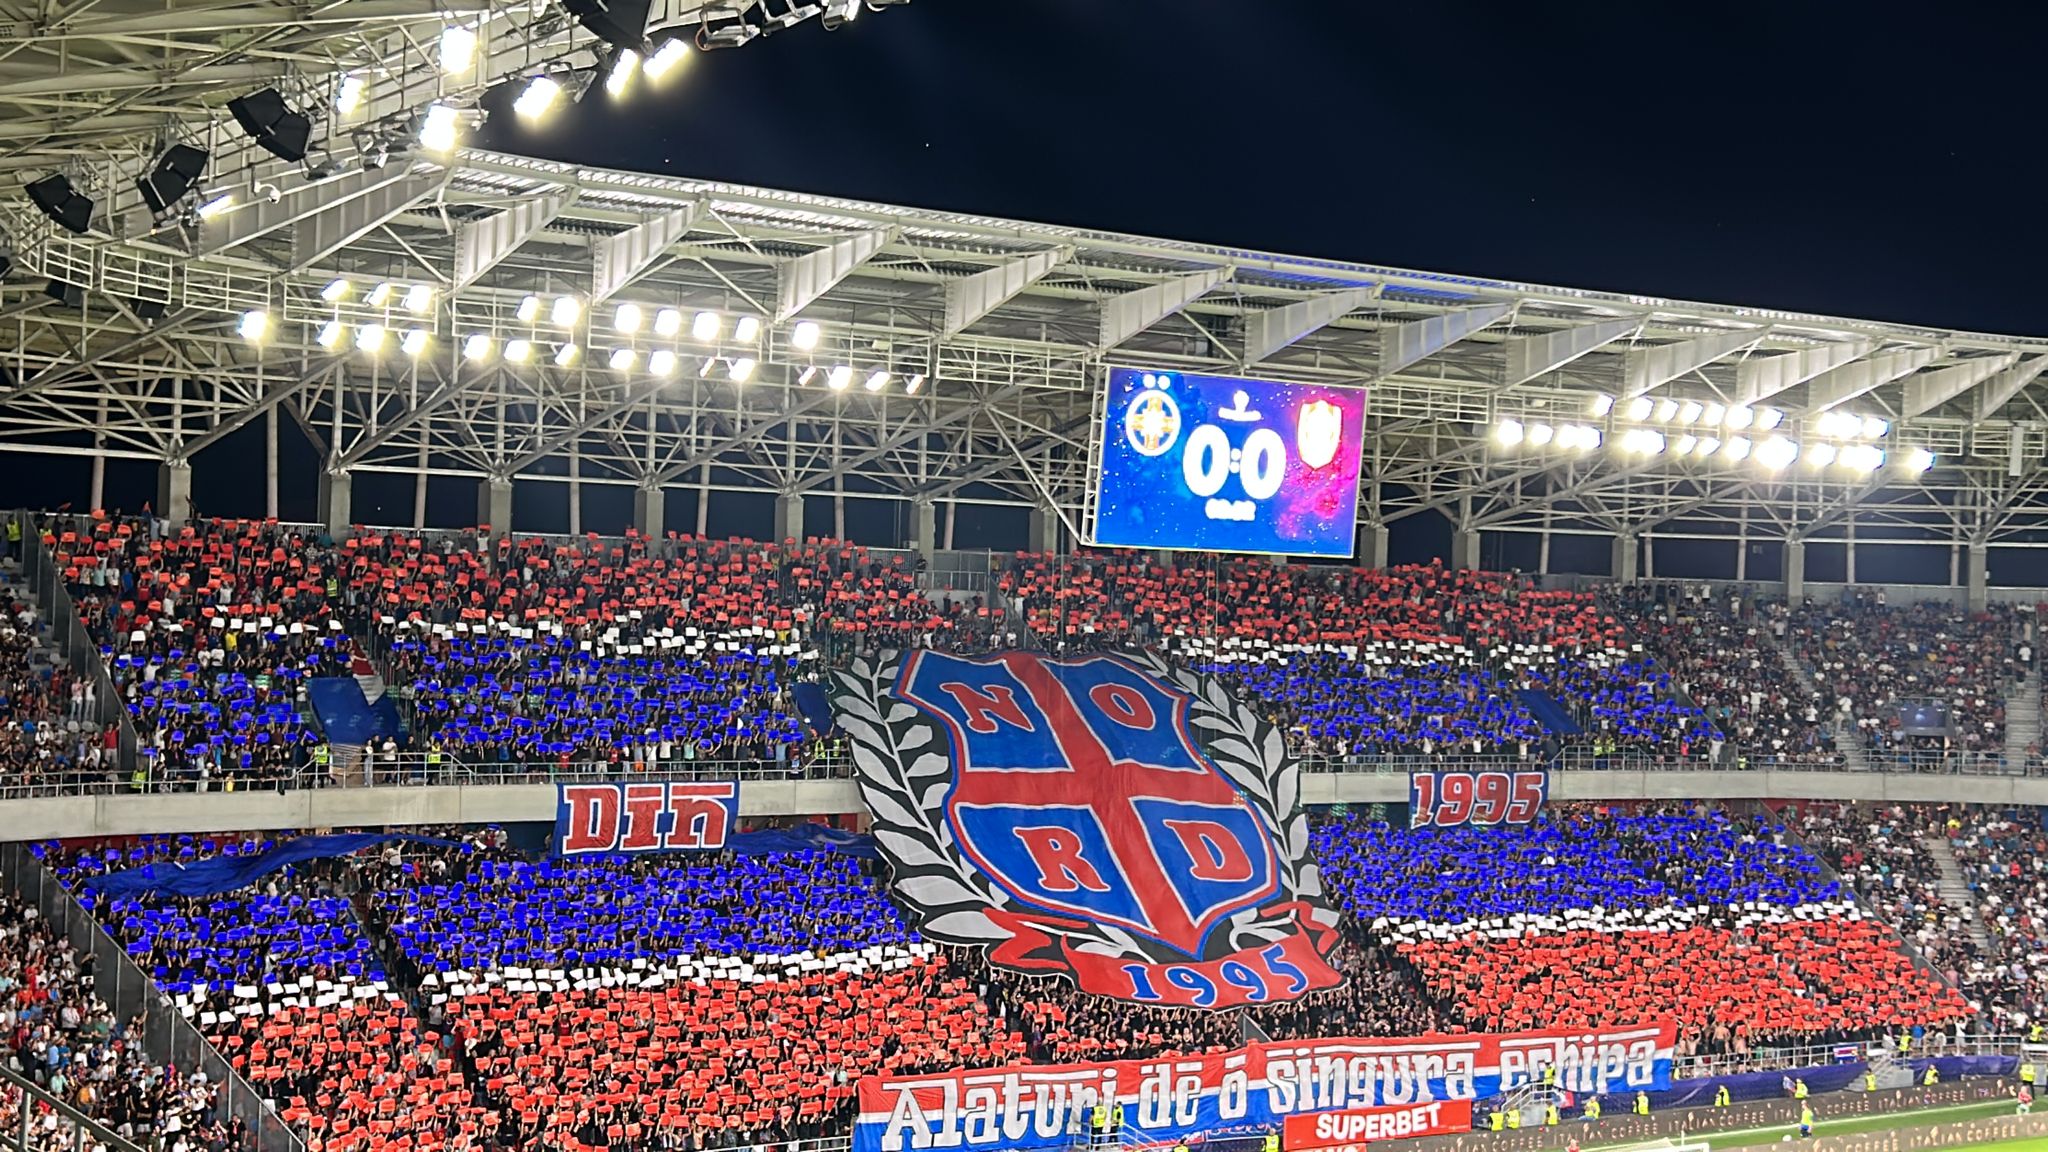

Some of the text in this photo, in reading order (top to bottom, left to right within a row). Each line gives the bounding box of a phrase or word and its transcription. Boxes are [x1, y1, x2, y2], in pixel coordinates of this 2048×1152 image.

[1411, 772, 1544, 830] 1995
[1120, 943, 1309, 1007] 1995
[1316, 1102, 1442, 1140] SUPERBET
